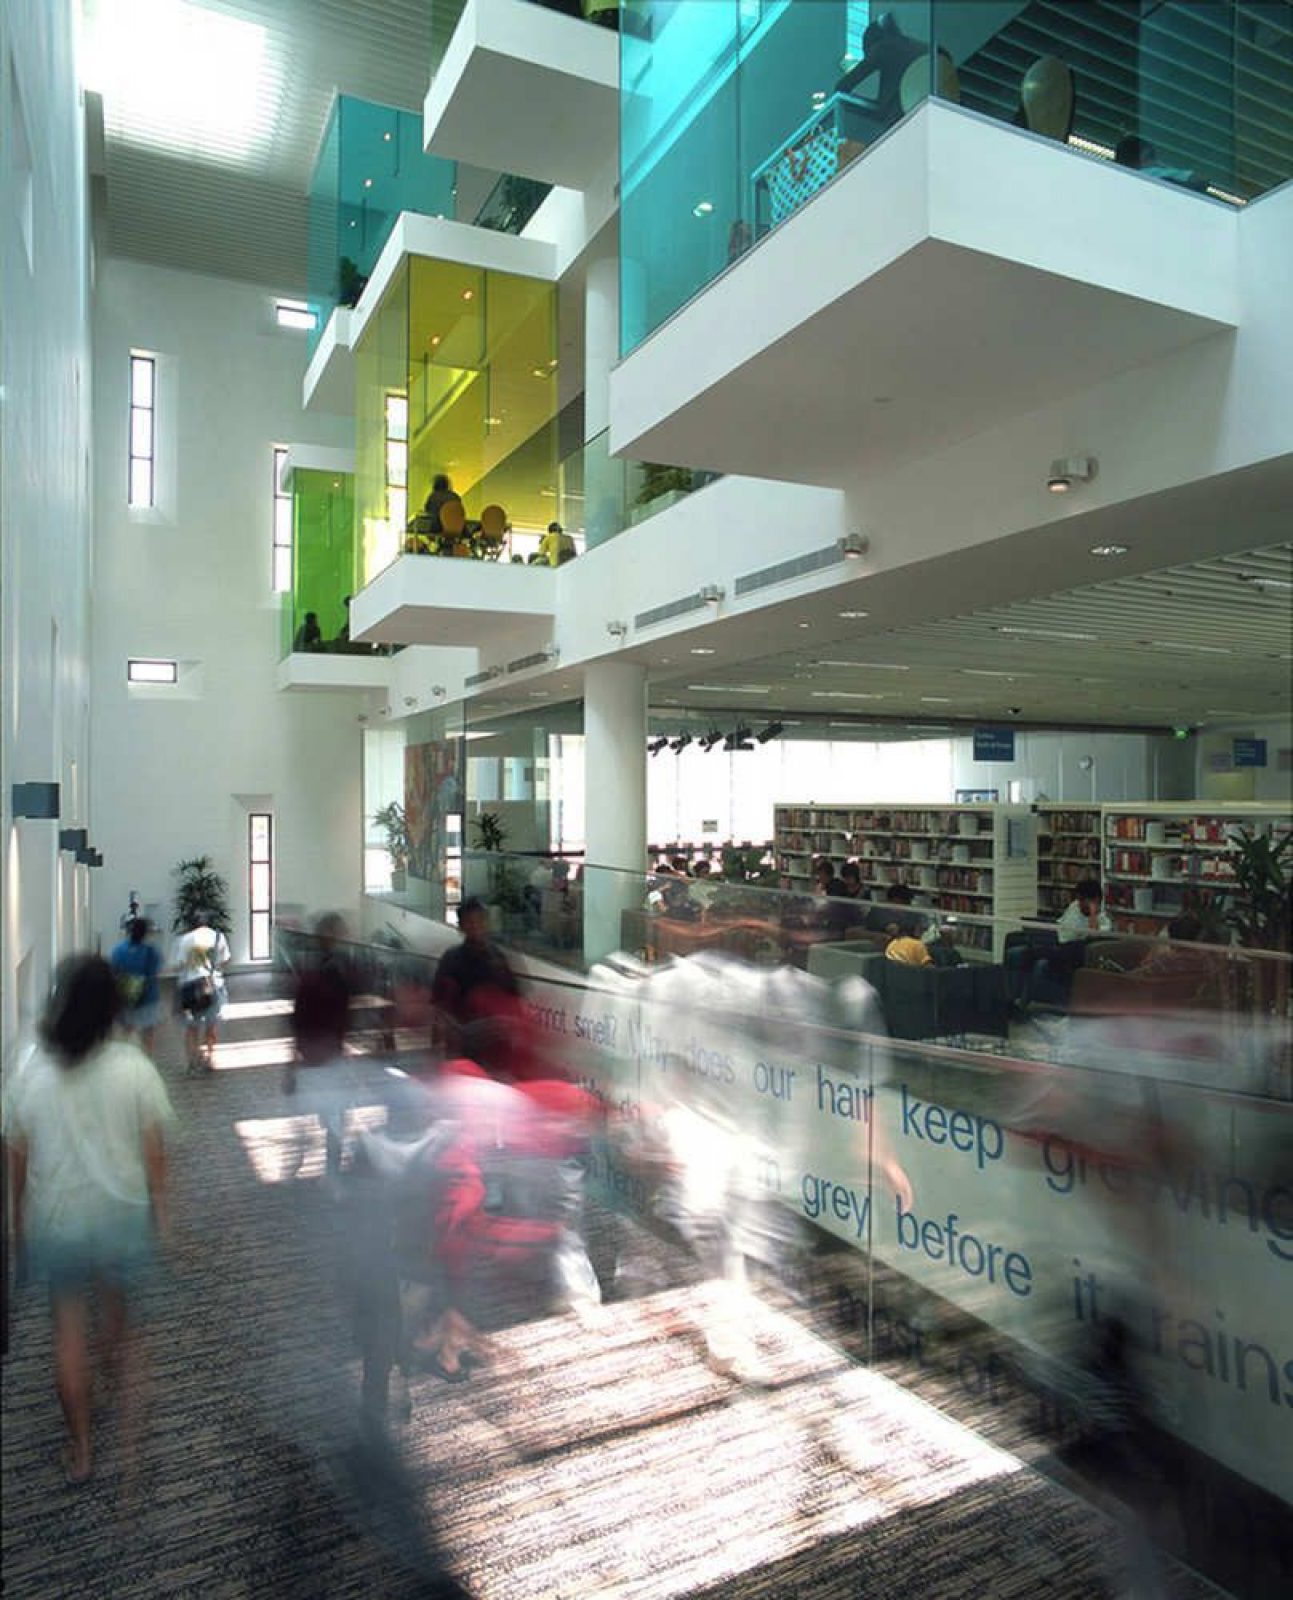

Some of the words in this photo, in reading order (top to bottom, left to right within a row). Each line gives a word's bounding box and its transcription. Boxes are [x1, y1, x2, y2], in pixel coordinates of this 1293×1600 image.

[754, 1061, 796, 1101] our
[816, 1064, 873, 1122] hair
[901, 1084, 1004, 1168] keep
[802, 1173, 870, 1238] grey
[895, 1194, 1033, 1297] before
[1072, 1258, 1102, 1321] it
